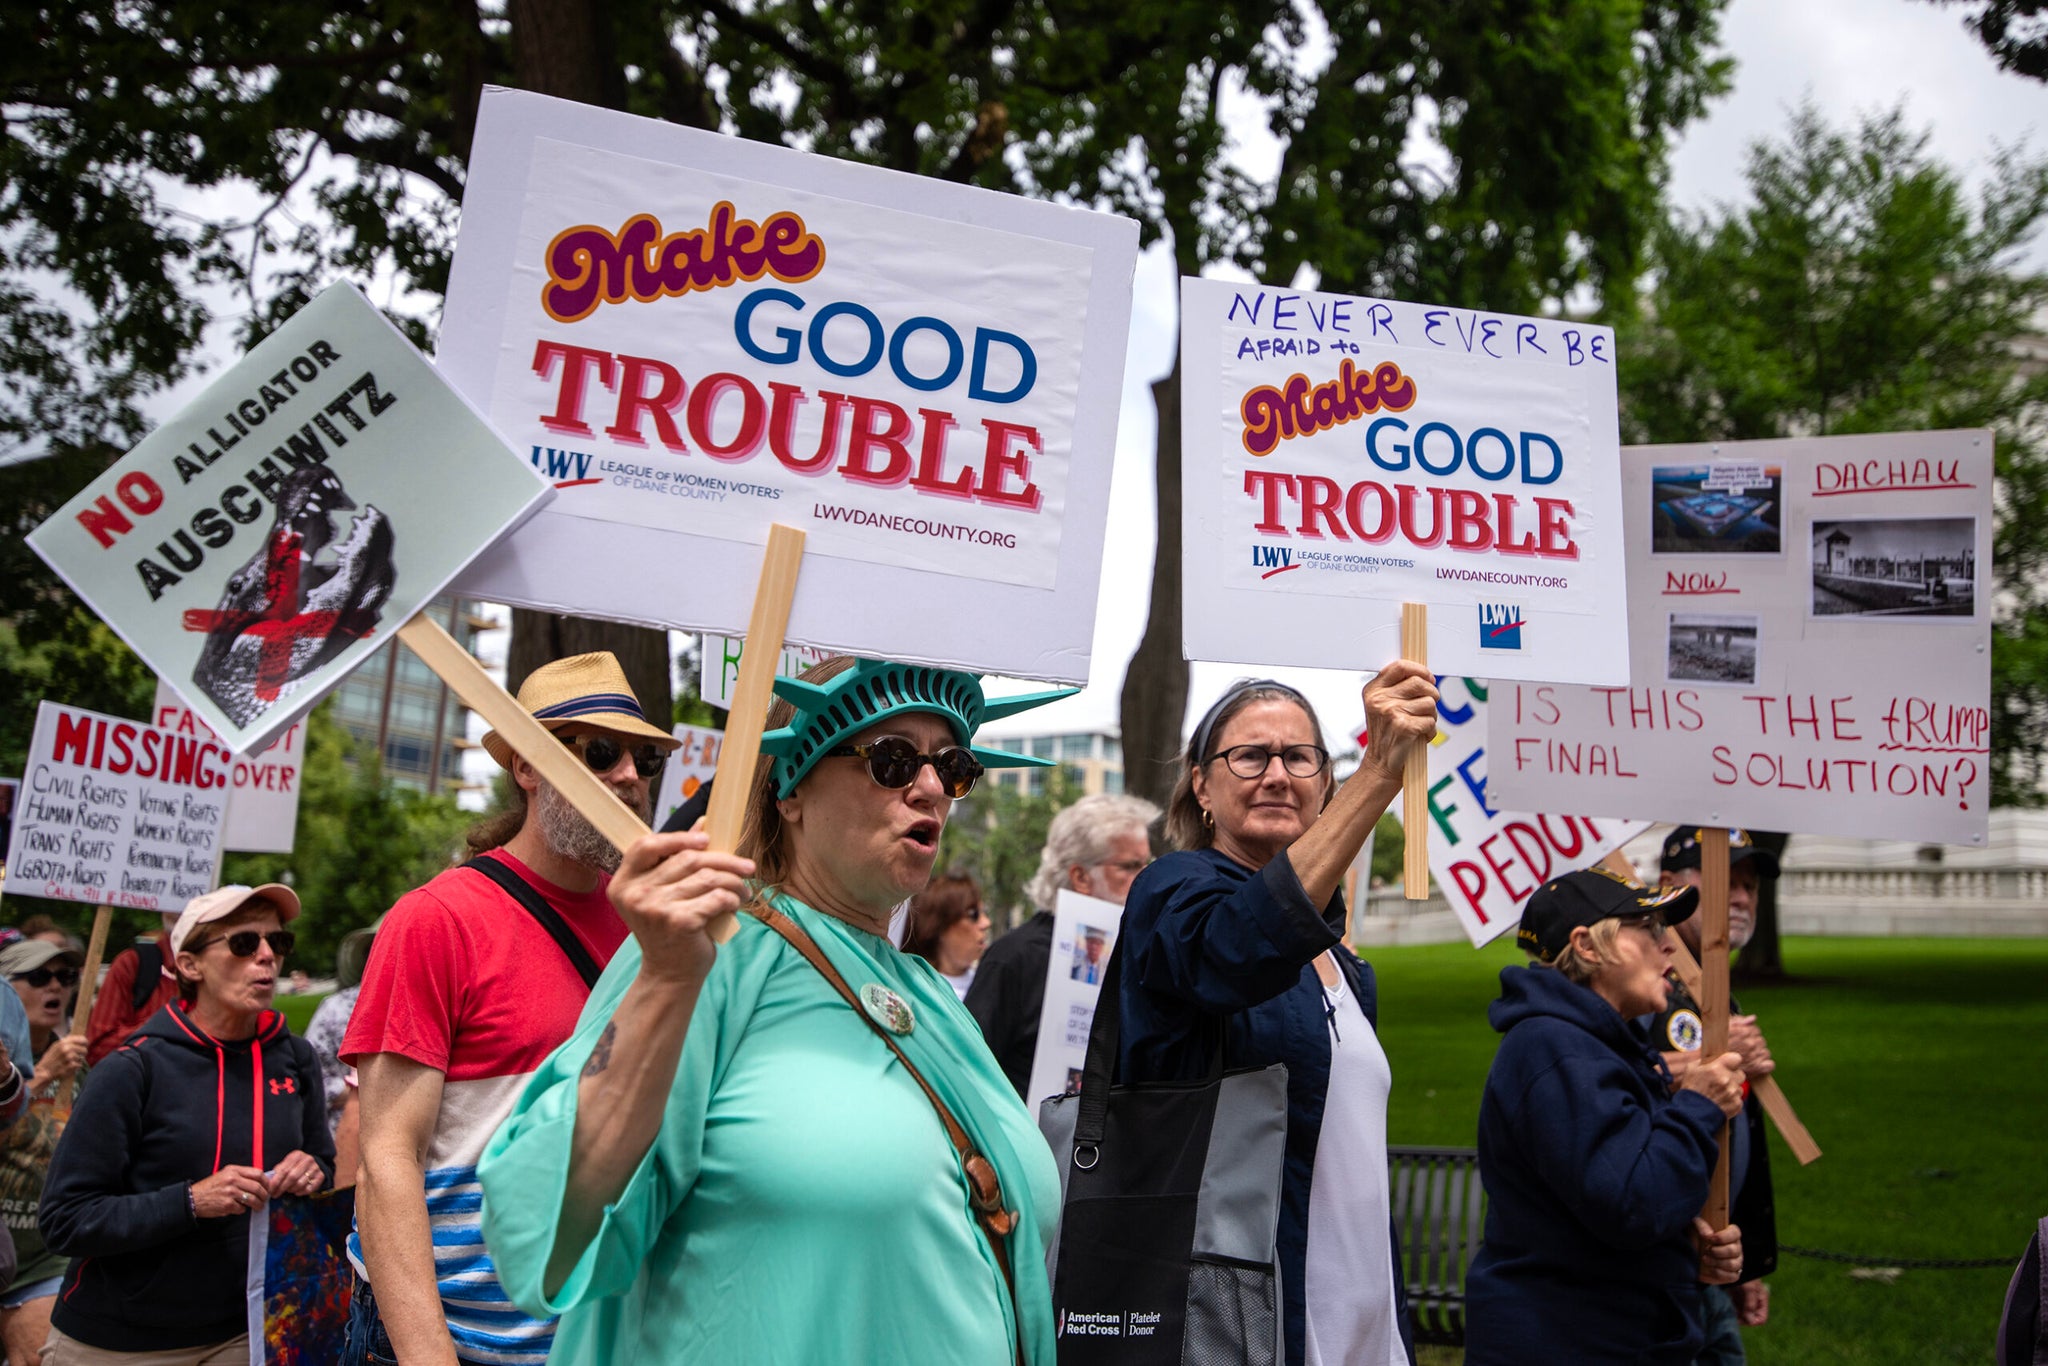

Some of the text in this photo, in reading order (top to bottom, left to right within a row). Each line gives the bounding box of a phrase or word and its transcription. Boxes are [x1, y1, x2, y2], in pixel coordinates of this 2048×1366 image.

[541, 200, 826, 323] Make
[1228, 292, 1609, 366] NEVER EVER BE
[734, 288, 1038, 404] GOOD
[1237, 337, 1320, 360] AFRAID
[1240, 358, 1417, 457] Make
[532, 339, 1043, 513] TROUBLE
[74, 339, 342, 550] NO ALLIGATOR
[1366, 417, 1563, 485] GOOD
[530, 445, 593, 481] LWV
[600, 460, 653, 478] LEAGUE
[673, 472, 727, 491] WOMEN
[1816, 459, 1960, 491] DACHAU
[136, 371, 398, 602] AUSCHWITZ
[613, 475, 727, 502] OF DANE COUNTY
[813, 503, 1017, 549] LWVDANECOUNTY.ORG
[1243, 470, 1580, 562] TROUBLE
[1252, 545, 1293, 568] LWV
[1297, 551, 1332, 562] LEAGUE
[1345, 555, 1380, 565] WOMEN
[1307, 561, 1380, 574] OF DANE COUNTY
[1436, 568, 1568, 589] LWVDANECOUNTY.ORG
[1667, 571, 1728, 592] NOW
[1479, 603, 1521, 625] LWV
[1515, 685, 1560, 725] IS
[1590, 687, 1704, 732] THIS
[1742, 695, 1862, 741] THE
[52, 712, 231, 790] MISSING:
[32, 764, 128, 809] CIVIL RIGHTS
[233, 762, 295, 793] OVER
[1515, 738, 1977, 811] FINAL SOLUTION?
[25, 794, 121, 834] HUMAN RIGHTS
[139, 786, 220, 825] VOTING RIGHTS
[20, 823, 115, 862] TRANS RIGHTS
[176, 820, 214, 850] RIGHTS
[72, 860, 108, 888] RIGHTS
[184, 848, 213, 876] RIGHTS
[44, 880, 77, 901] CALL
[83, 887, 101, 903] 911
[120, 892, 158, 911] FOUND
[1066, 1323, 1120, 1335] Red Cross
[1067, 1311, 1120, 1323] American
[1129, 1311, 1160, 1323] Platelet
[1129, 1324, 1155, 1335] Donor
